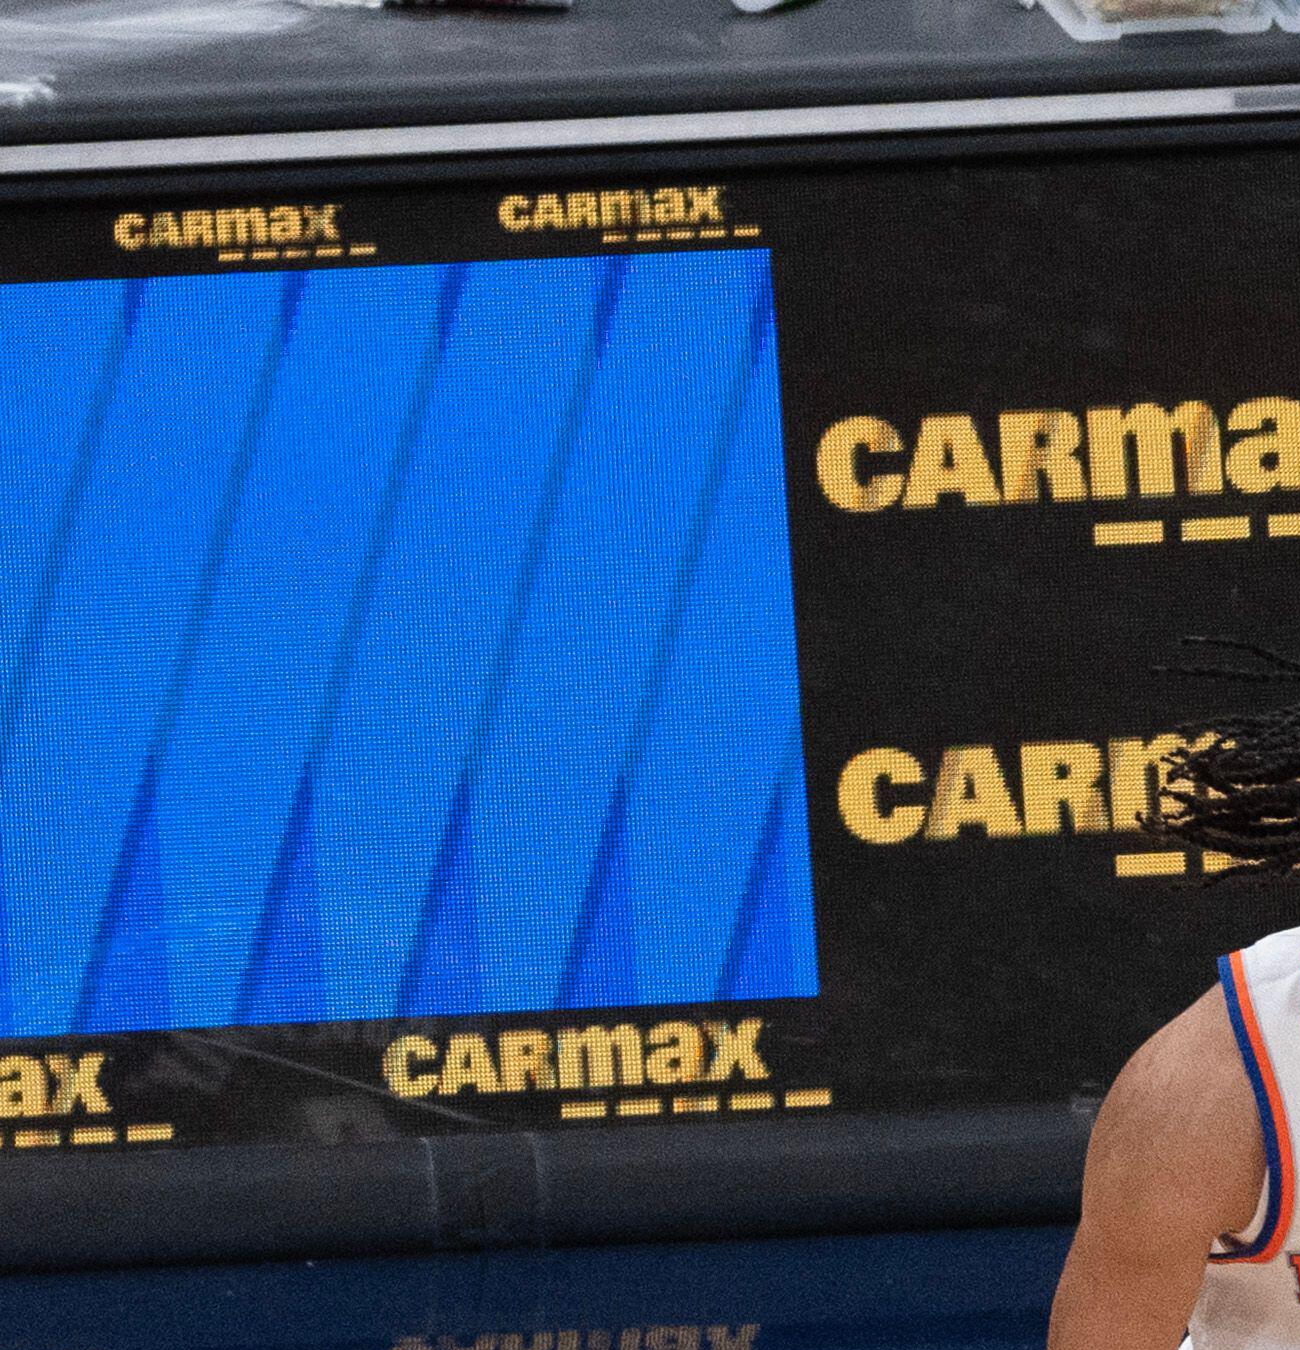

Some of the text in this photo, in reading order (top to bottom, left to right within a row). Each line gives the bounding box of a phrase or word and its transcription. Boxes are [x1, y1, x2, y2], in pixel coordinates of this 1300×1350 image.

[114, 204, 343, 251] CARmax
[498, 185, 724, 233] CARmax
[382, 1016, 772, 1099] CARmax
